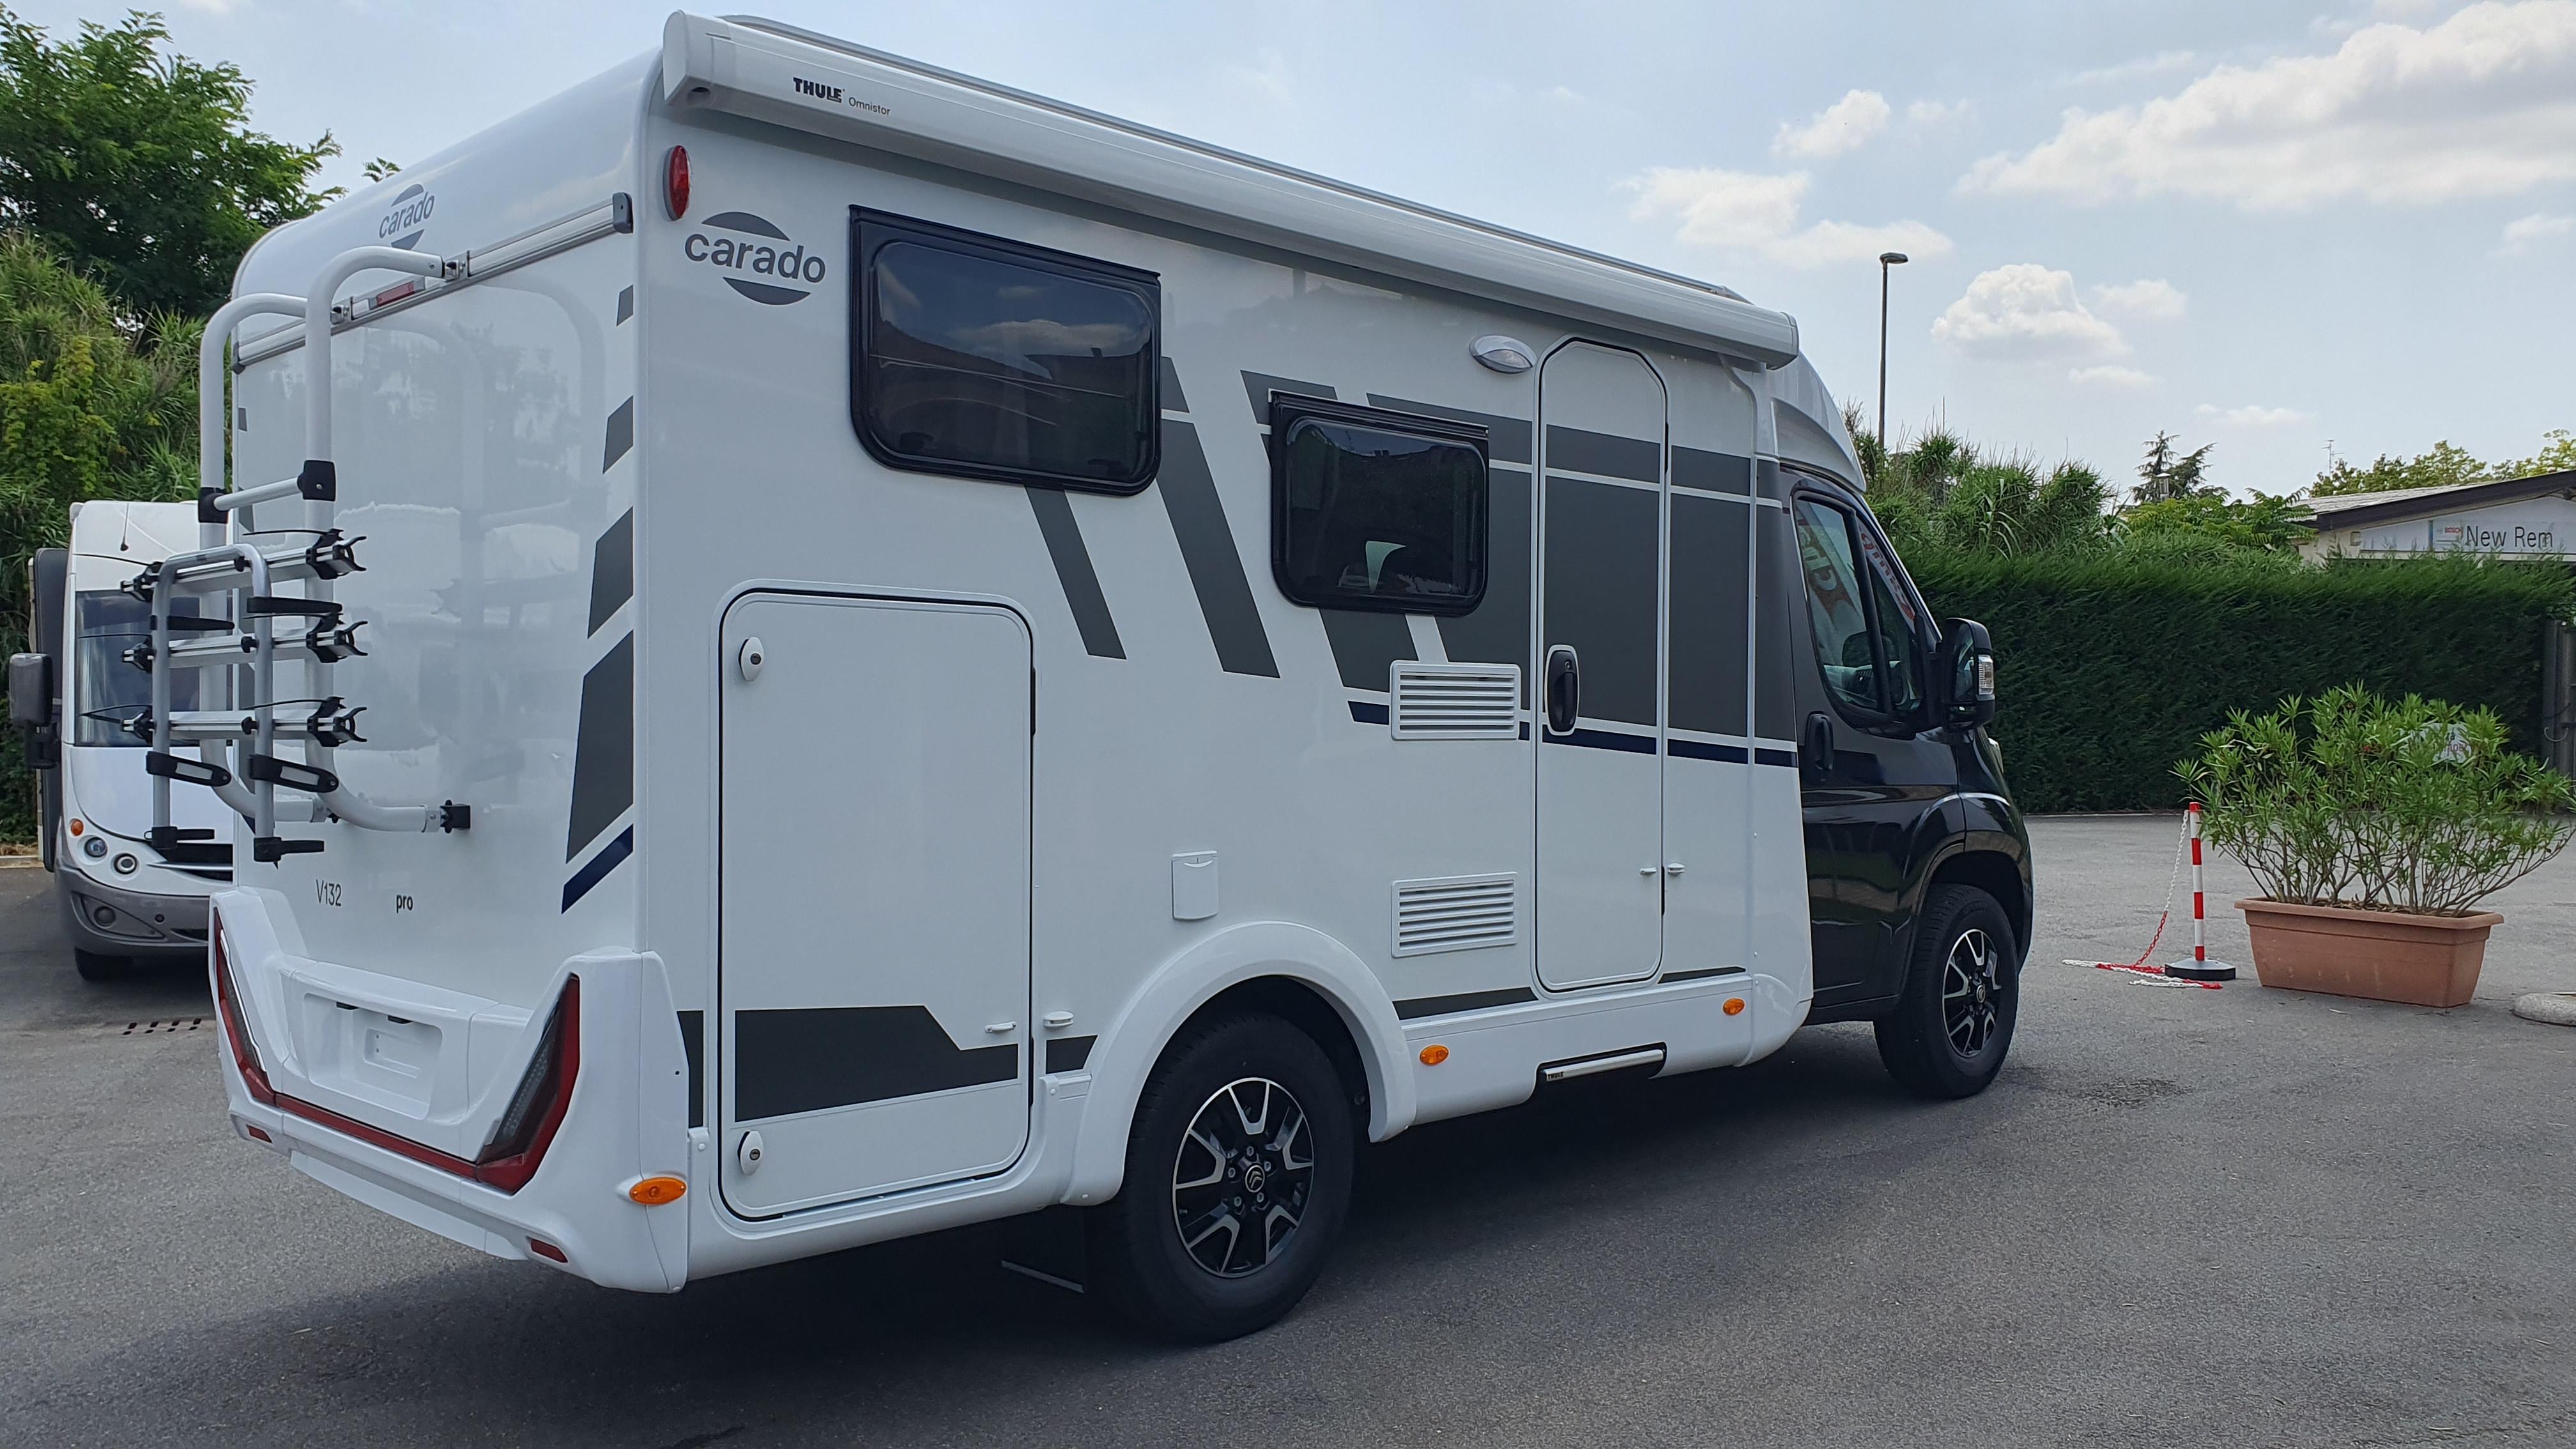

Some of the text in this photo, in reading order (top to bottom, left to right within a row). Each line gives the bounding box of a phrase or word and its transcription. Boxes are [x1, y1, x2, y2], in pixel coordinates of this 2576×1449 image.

[793, 77, 891, 116] THULE Omnistor
[379, 191, 435, 239] carado
[684, 234, 826, 284] carado
[2466, 525, 2553, 548] New Rem
[316, 878, 413, 914] V132 pro
